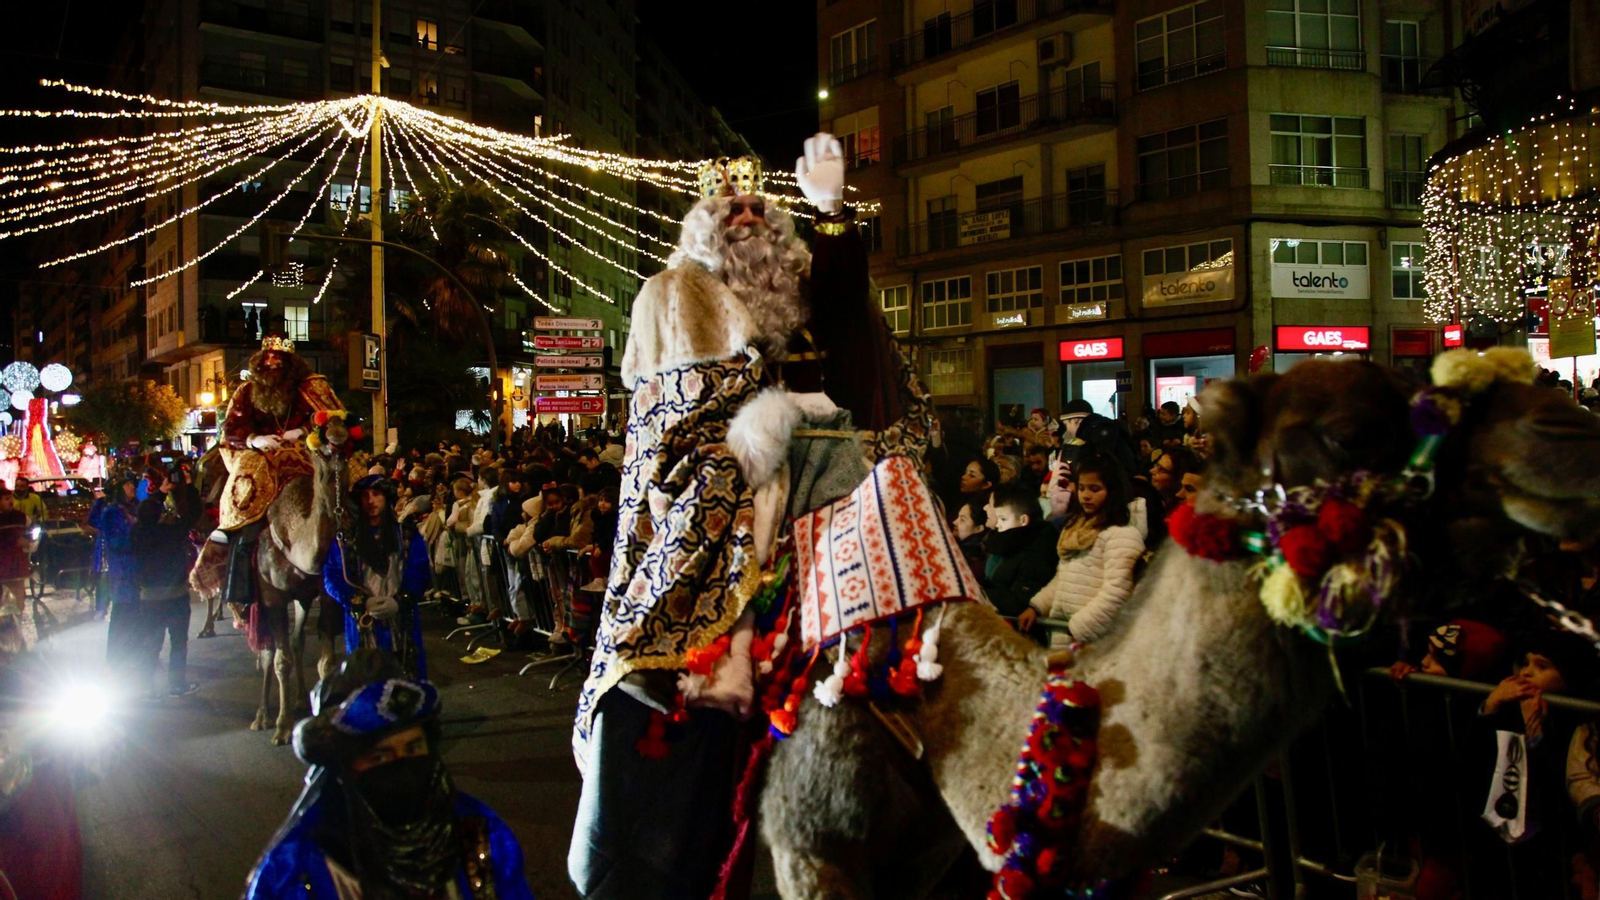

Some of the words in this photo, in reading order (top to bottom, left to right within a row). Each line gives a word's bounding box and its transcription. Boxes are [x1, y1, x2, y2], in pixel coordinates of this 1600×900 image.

[1160, 276, 1216, 296] talento
[1292, 271, 1348, 288] talento
[1303, 330, 1342, 346] GAES
[1074, 342, 1108, 357] GAES
[1116, 378, 1132, 386] TAXI
